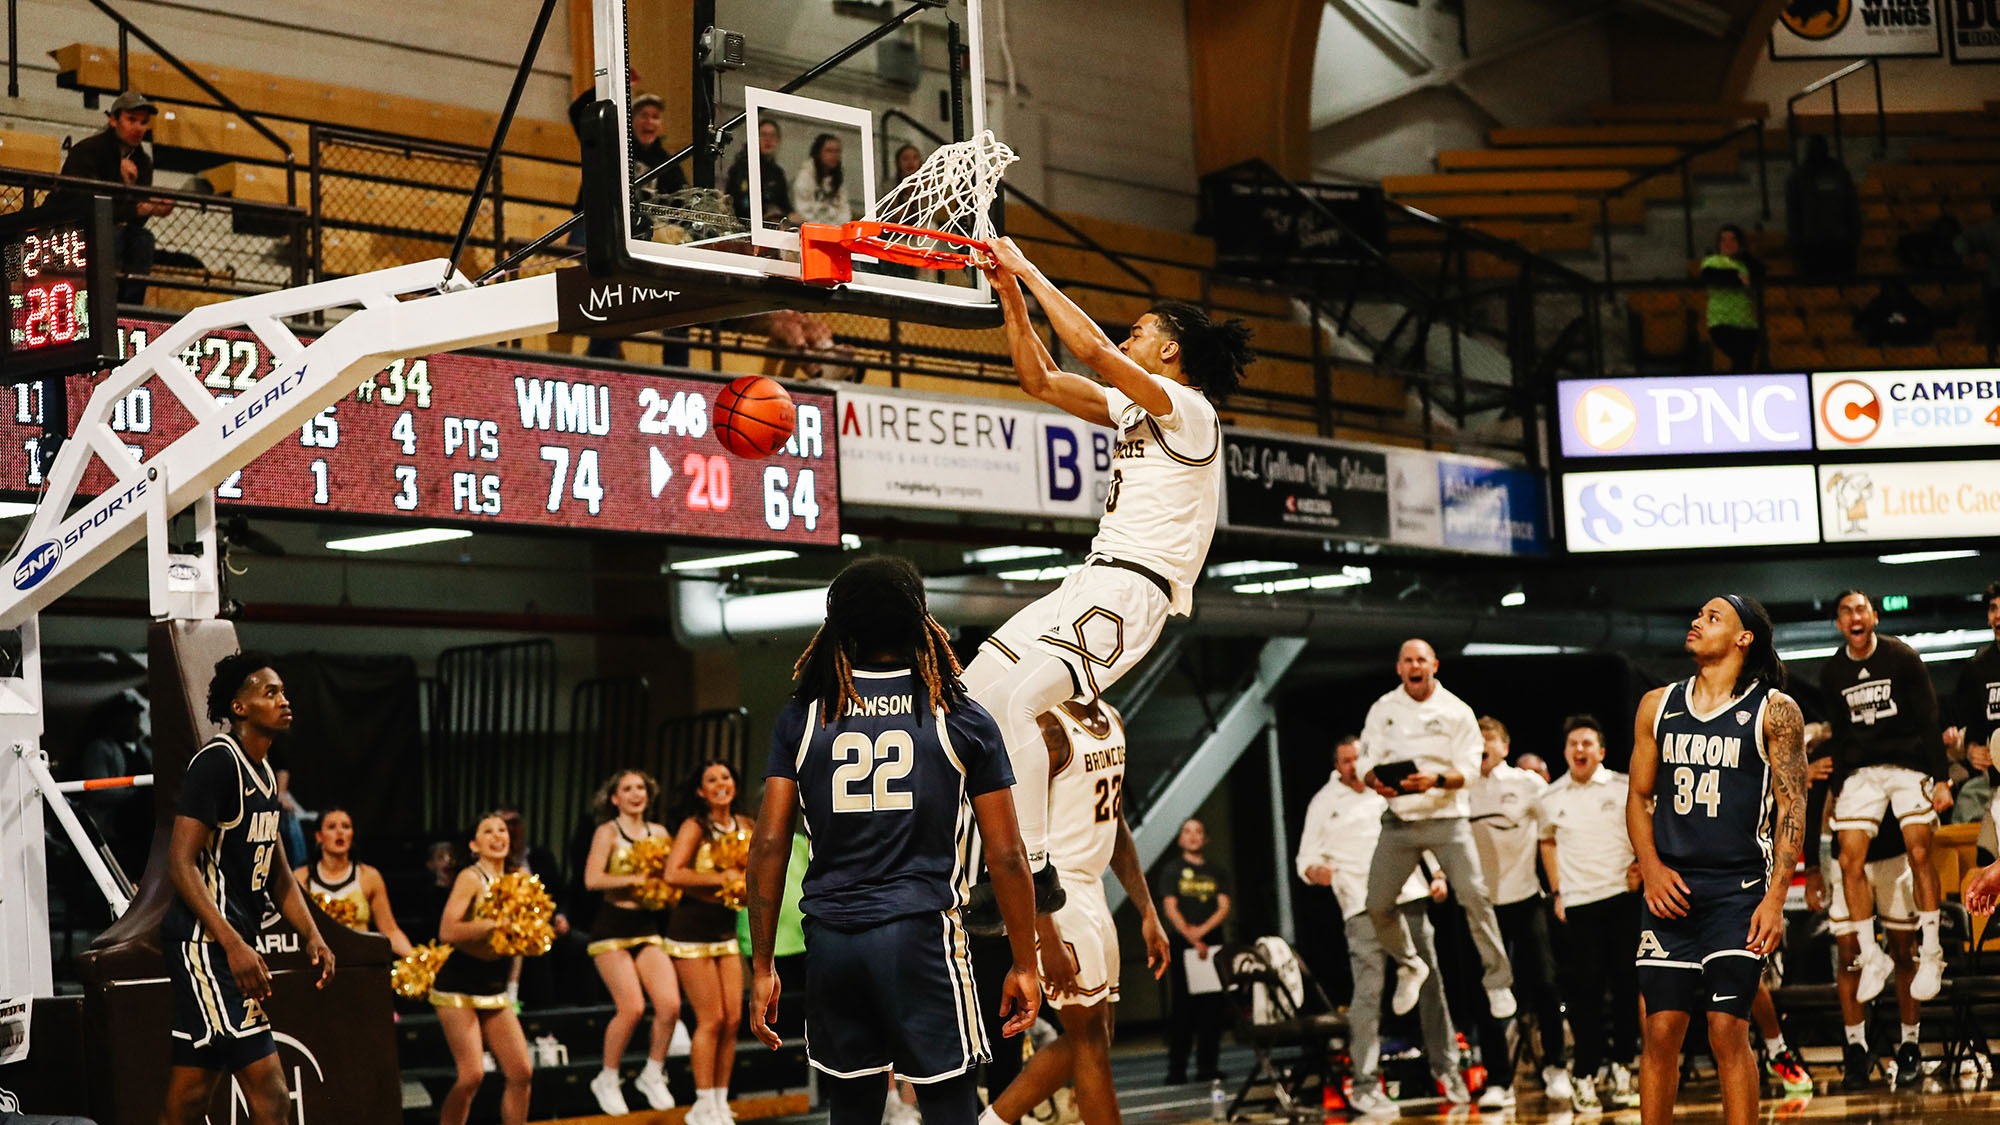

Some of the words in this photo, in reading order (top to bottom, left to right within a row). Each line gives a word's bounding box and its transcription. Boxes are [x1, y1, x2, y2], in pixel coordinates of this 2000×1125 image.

[1861, 8, 1931, 26] WINGS
[25, 282, 74, 345] 20
[112, 387, 152, 433] 10
[300, 406, 339, 449] 15
[391, 410, 417, 455] 4
[444, 416, 499, 460] PTS
[221, 364, 309, 440] LEGACY
[514, 376, 610, 436] WMU
[638, 387, 708, 438] 2:46
[1647, 384, 1800, 446] PNC
[1892, 405, 1974, 427] FORD
[310, 458, 329, 505] 1
[393, 465, 418, 511] 3
[453, 471, 501, 516] FLS
[540, 446, 603, 515] 74
[684, 453, 732, 512] 20
[1045, 424, 1082, 501] B
[64, 479, 147, 550] SPORTS
[763, 465, 820, 532] 64
[1632, 483, 1801, 534] Schupan
[1881, 484, 1949, 515] Little
[832, 729, 914, 813] 22
[1662, 732, 1741, 768] AKRON
[1094, 773, 1122, 824] 22
[1673, 766, 1721, 818] 34
